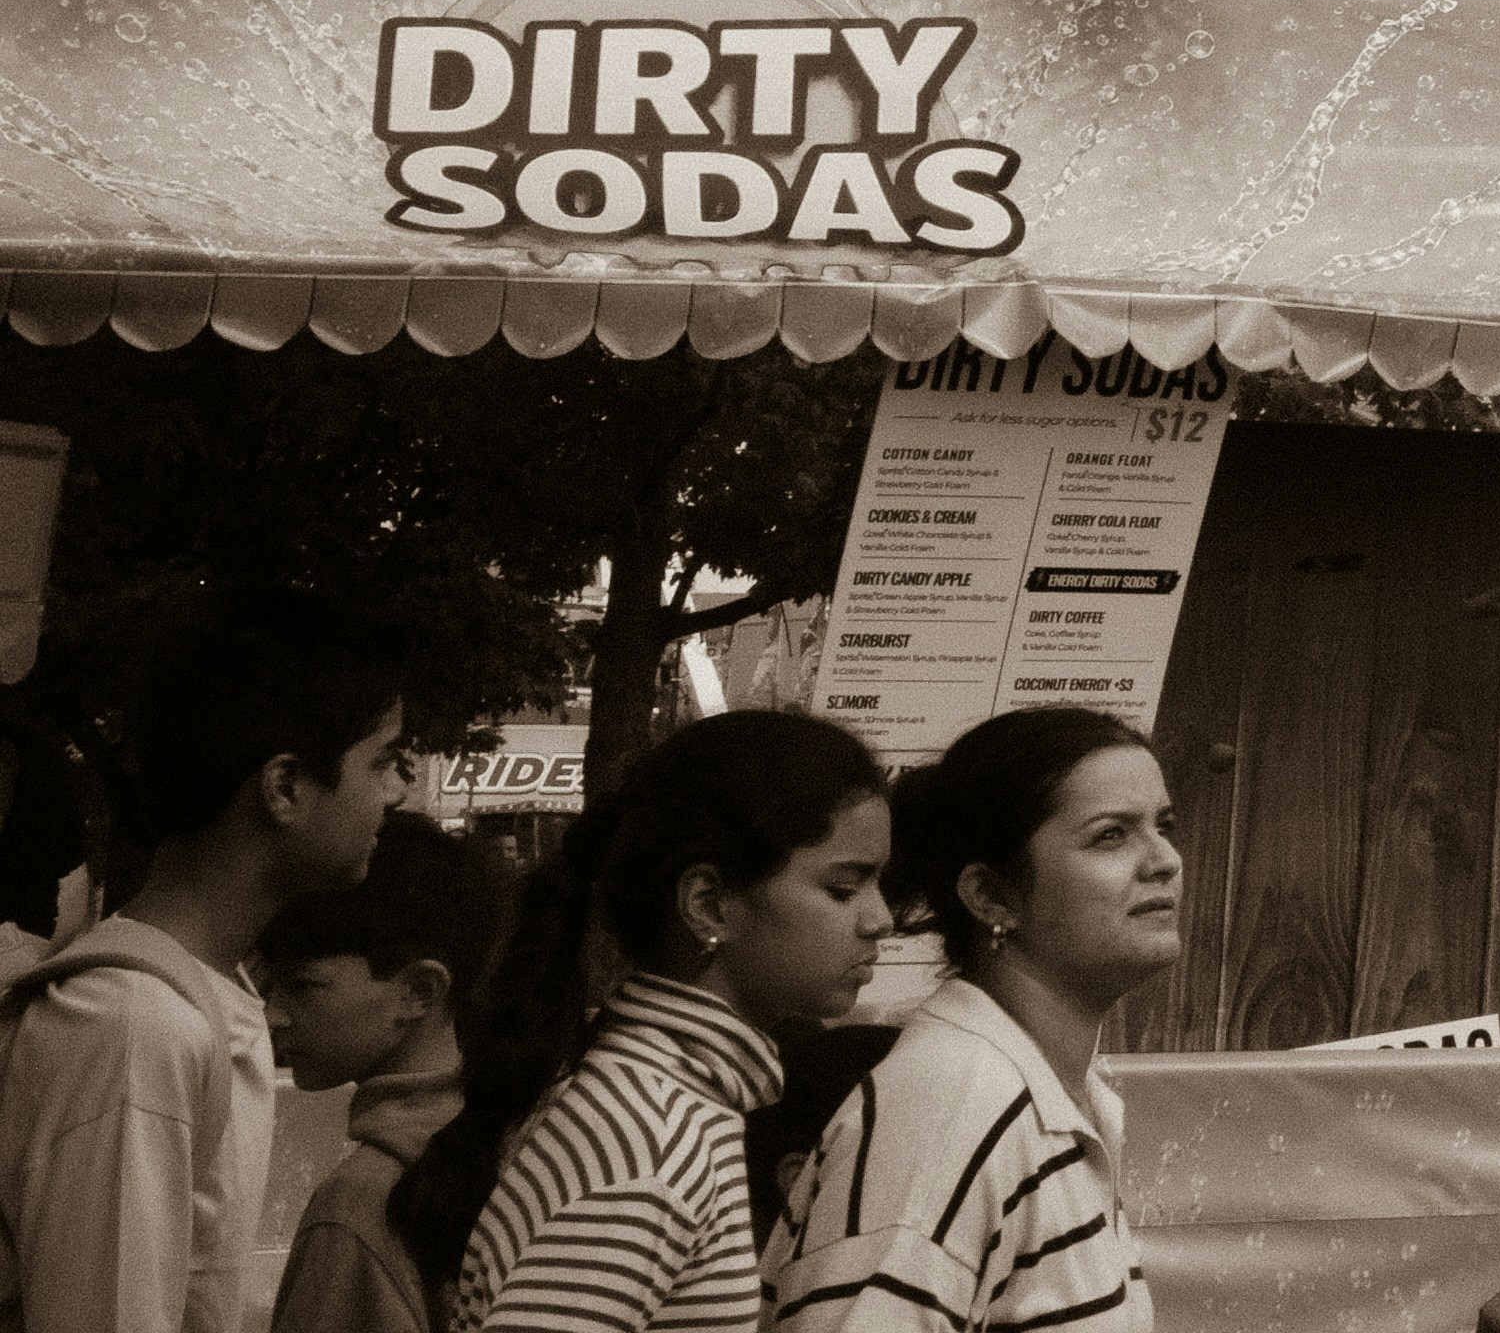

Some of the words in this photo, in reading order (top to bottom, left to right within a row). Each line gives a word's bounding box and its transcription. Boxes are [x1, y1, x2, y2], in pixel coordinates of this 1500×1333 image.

[373, 17, 978, 142] DIRTY
[384, 139, 1026, 257] SODAS
[1145, 406, 1208, 443] $12
[882, 448, 930, 460] COTTON
[933, 450, 975, 461] CANDY
[1066, 453, 1115, 466] ORANGE
[1117, 455, 1154, 467] FLOAT
[867, 508, 921, 524] COOKIES
[922, 510, 931, 523] &
[933, 510, 977, 525] CREAM
[1051, 514, 1097, 527] CHERRY
[1098, 515, 1127, 527] COLA
[1128, 516, 1162, 529] FLOAT
[853, 571, 891, 586] DIRTY
[891, 572, 933, 586] CANDY
[932, 573, 973, 587] APPLE
[1048, 574, 1090, 586] ENERGY
[1089, 575, 1122, 587] DIRTY
[1121, 576, 1158, 589] SODAS
[1029, 611, 1064, 623] DIRTY
[1064, 611, 1105, 624] COFFEE
[839, 634, 912, 648] STARBURST
[1014, 678, 1068, 691] COCONUT
[1068, 678, 1112, 692] ENERGY
[446, 754, 583, 789] RIDE
